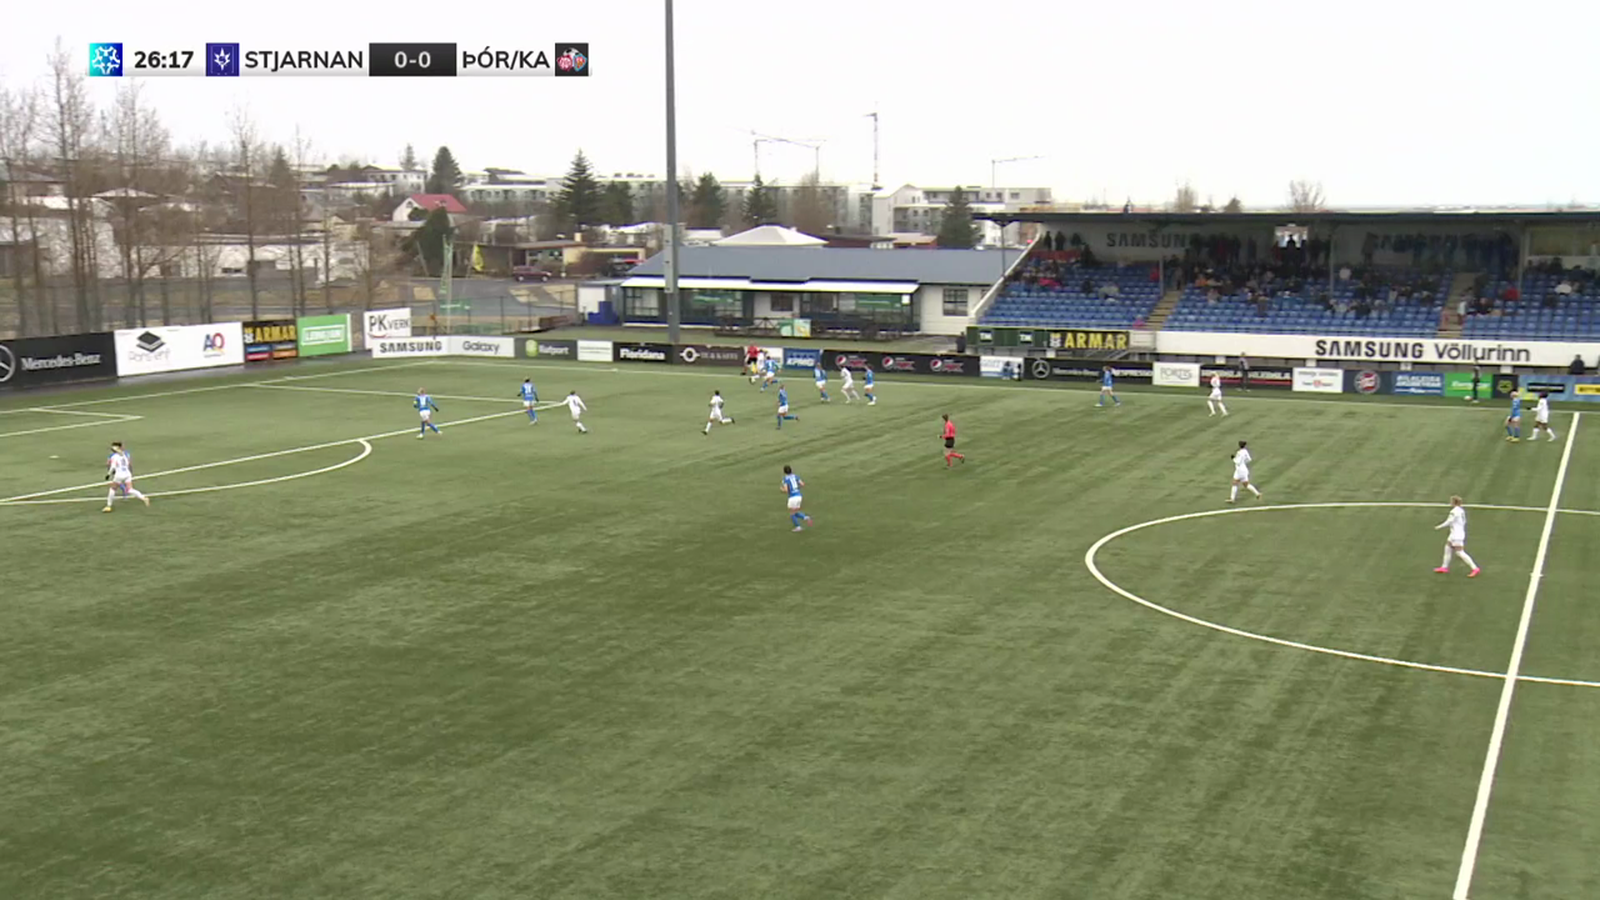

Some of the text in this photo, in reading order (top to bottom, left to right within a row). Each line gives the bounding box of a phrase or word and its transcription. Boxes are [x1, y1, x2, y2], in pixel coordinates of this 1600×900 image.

[1106, 233, 1193, 248] SAMSUN
[368, 314, 387, 331] PK
[254, 325, 297, 343] ARMAR
[1064, 333, 1129, 350] ARMAR
[380, 341, 442, 354] SAMSUNG
[462, 341, 500, 354] Galaxy
[1315, 339, 1530, 362] SAMSUNG Völlurinn
[21, 352, 101, 371] Mercedes-Benz
